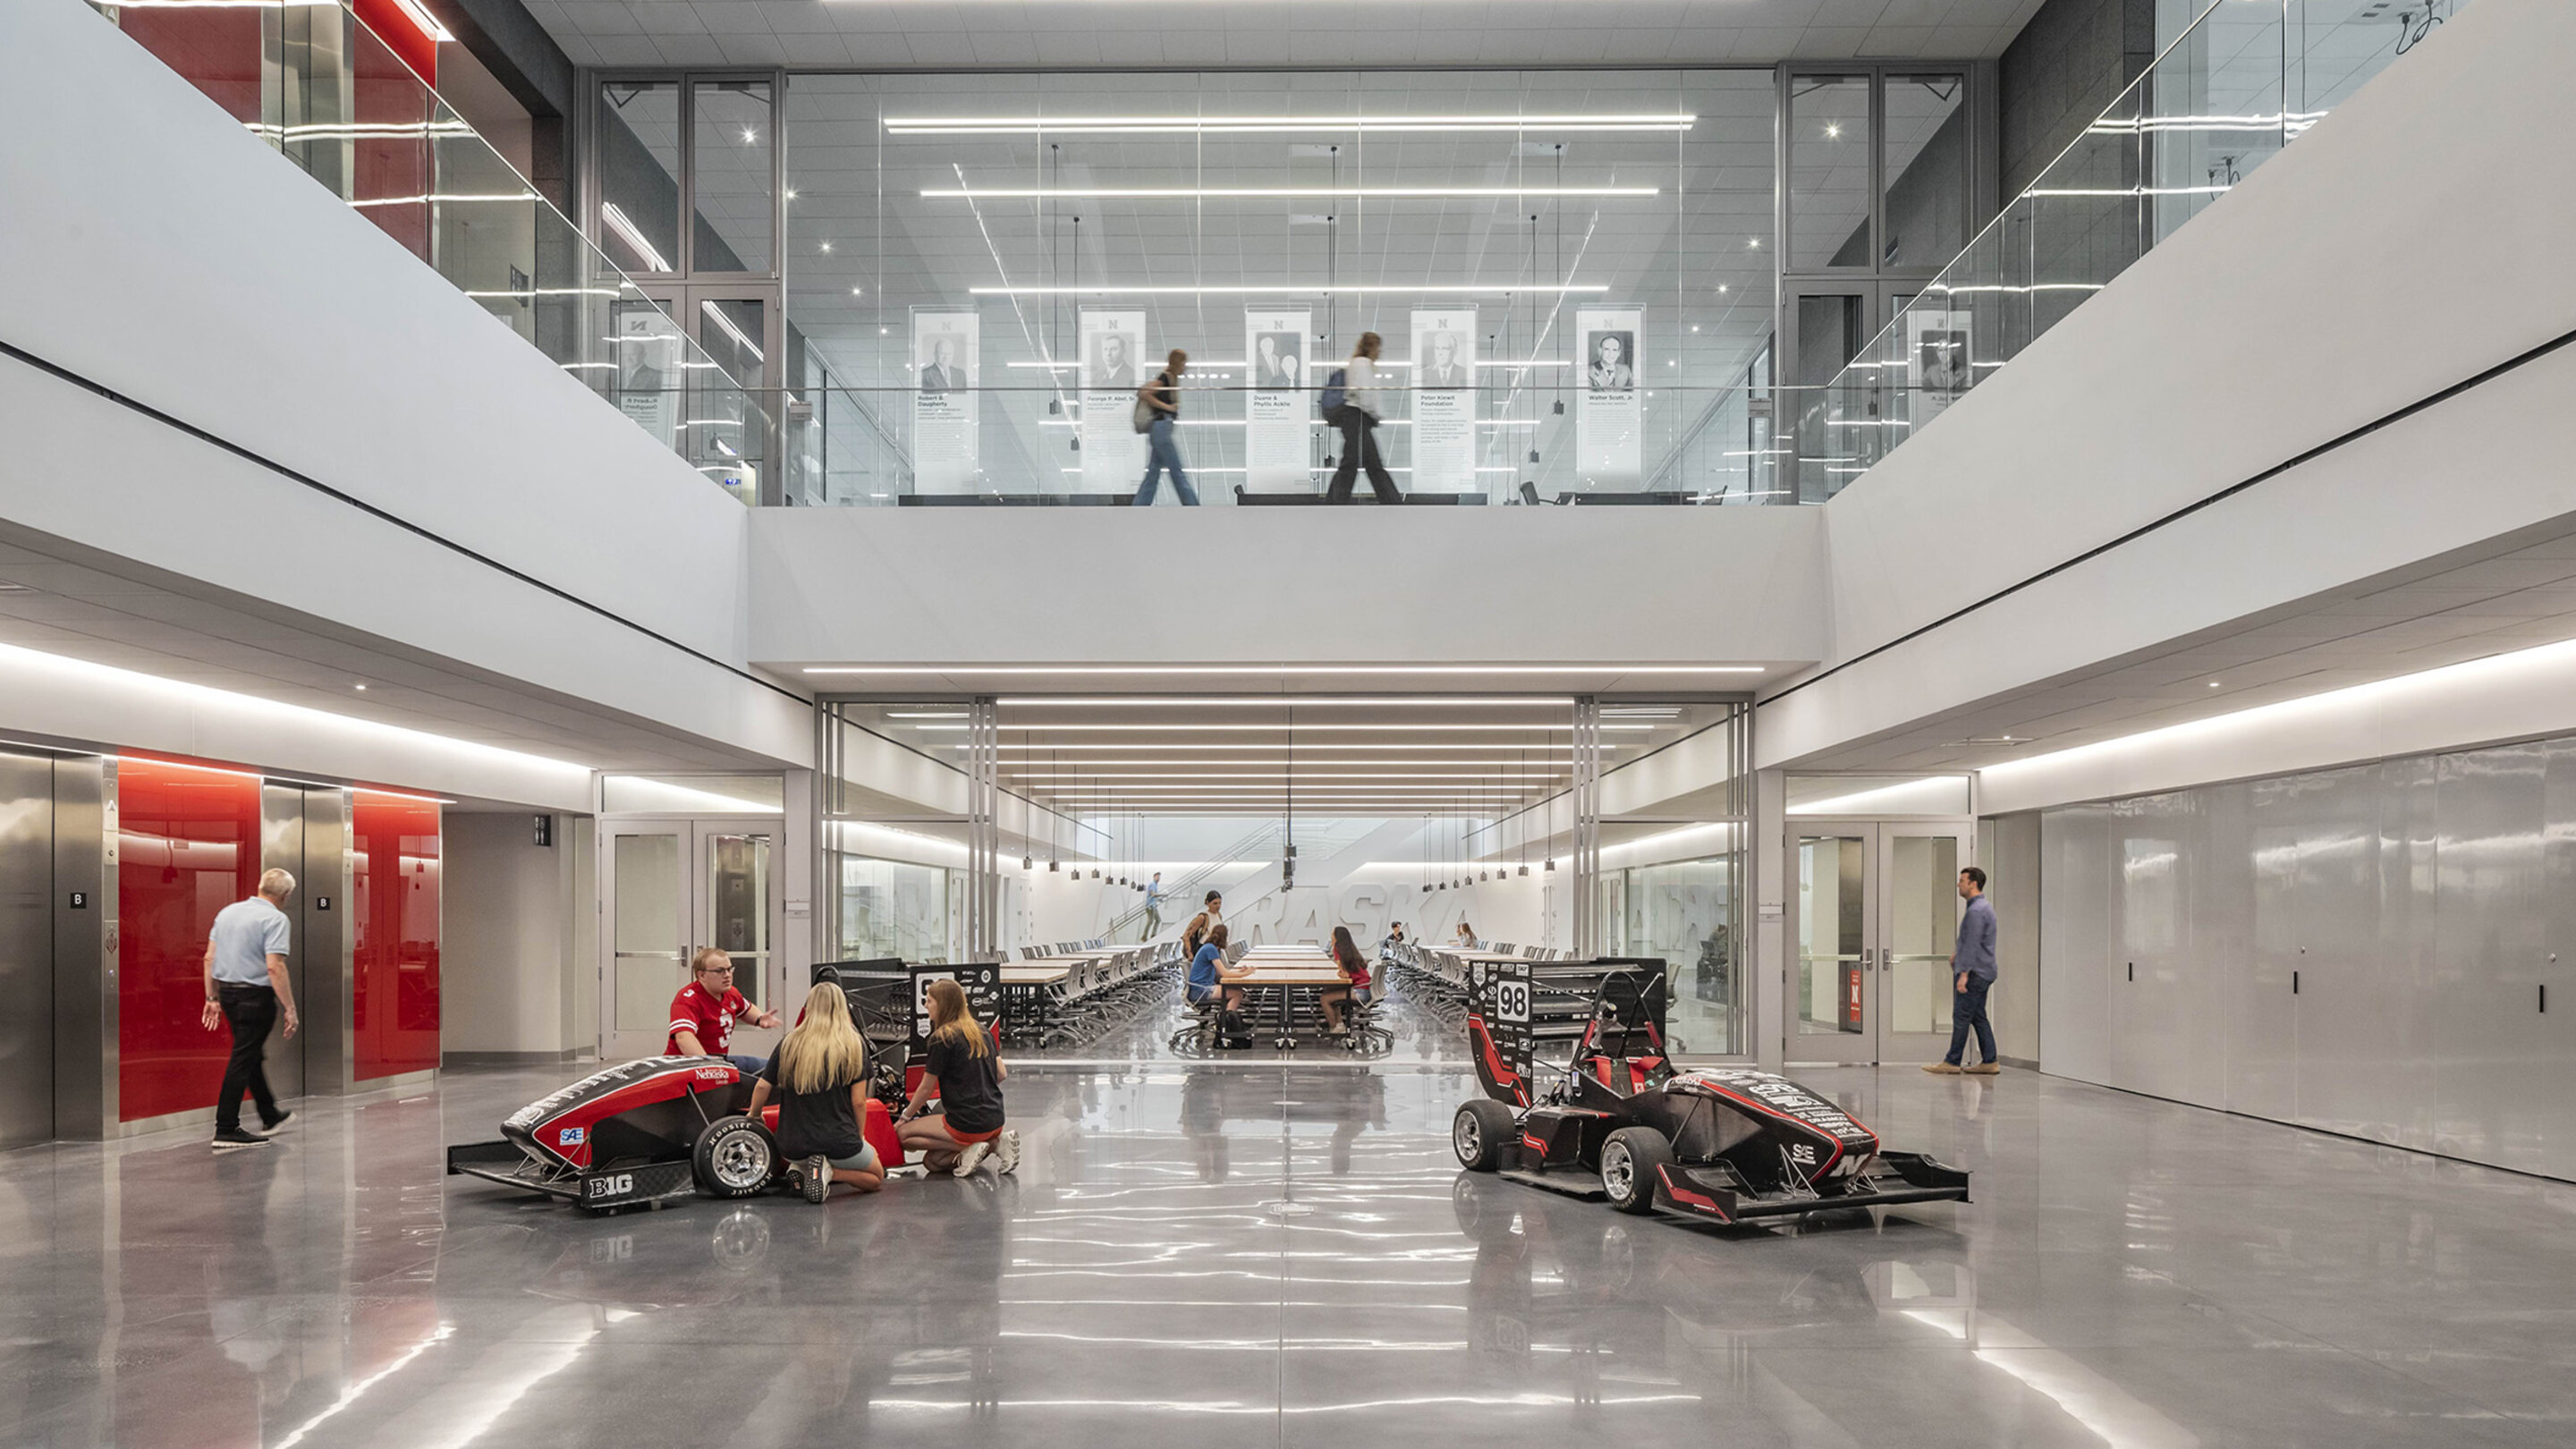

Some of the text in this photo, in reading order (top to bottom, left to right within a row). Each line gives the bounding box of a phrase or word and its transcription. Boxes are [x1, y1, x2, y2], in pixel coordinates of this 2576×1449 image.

[1274, 320, 1284, 330] N
[1437, 318, 1448, 329] N
[74, 894, 82, 905] B
[320, 898, 327, 908] B
[683, 988, 695, 997] 3
[1852, 985, 1859, 1004] N
[1500, 986, 1527, 1017] 98
[718, 1013, 733, 1048] 3
[695, 1068, 729, 1080] Nebraska
[561, 1129, 583, 1141] SAE
[708, 1122, 752, 1146] HOOSIER
[1792, 1143, 1814, 1160] SAE
[1828, 1153, 1872, 1177] N
[731, 1172, 773, 1196] HOOSIER
